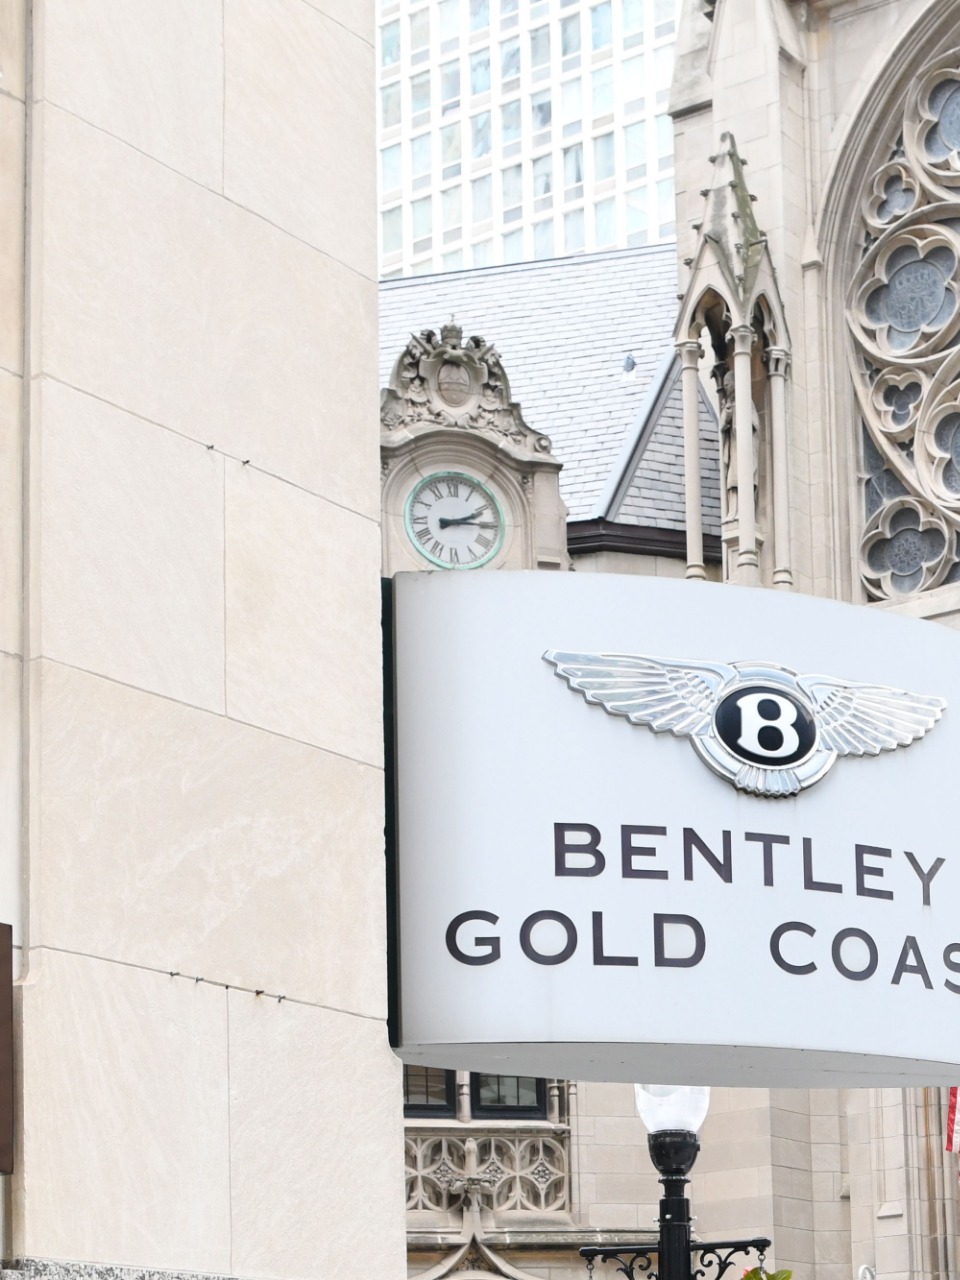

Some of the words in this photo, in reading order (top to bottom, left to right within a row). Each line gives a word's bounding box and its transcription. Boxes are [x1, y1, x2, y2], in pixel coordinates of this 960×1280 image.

[735, 698, 800, 759] B
[552, 822, 946, 906] BENTLEY
[445, 910, 707, 968] GOLD
